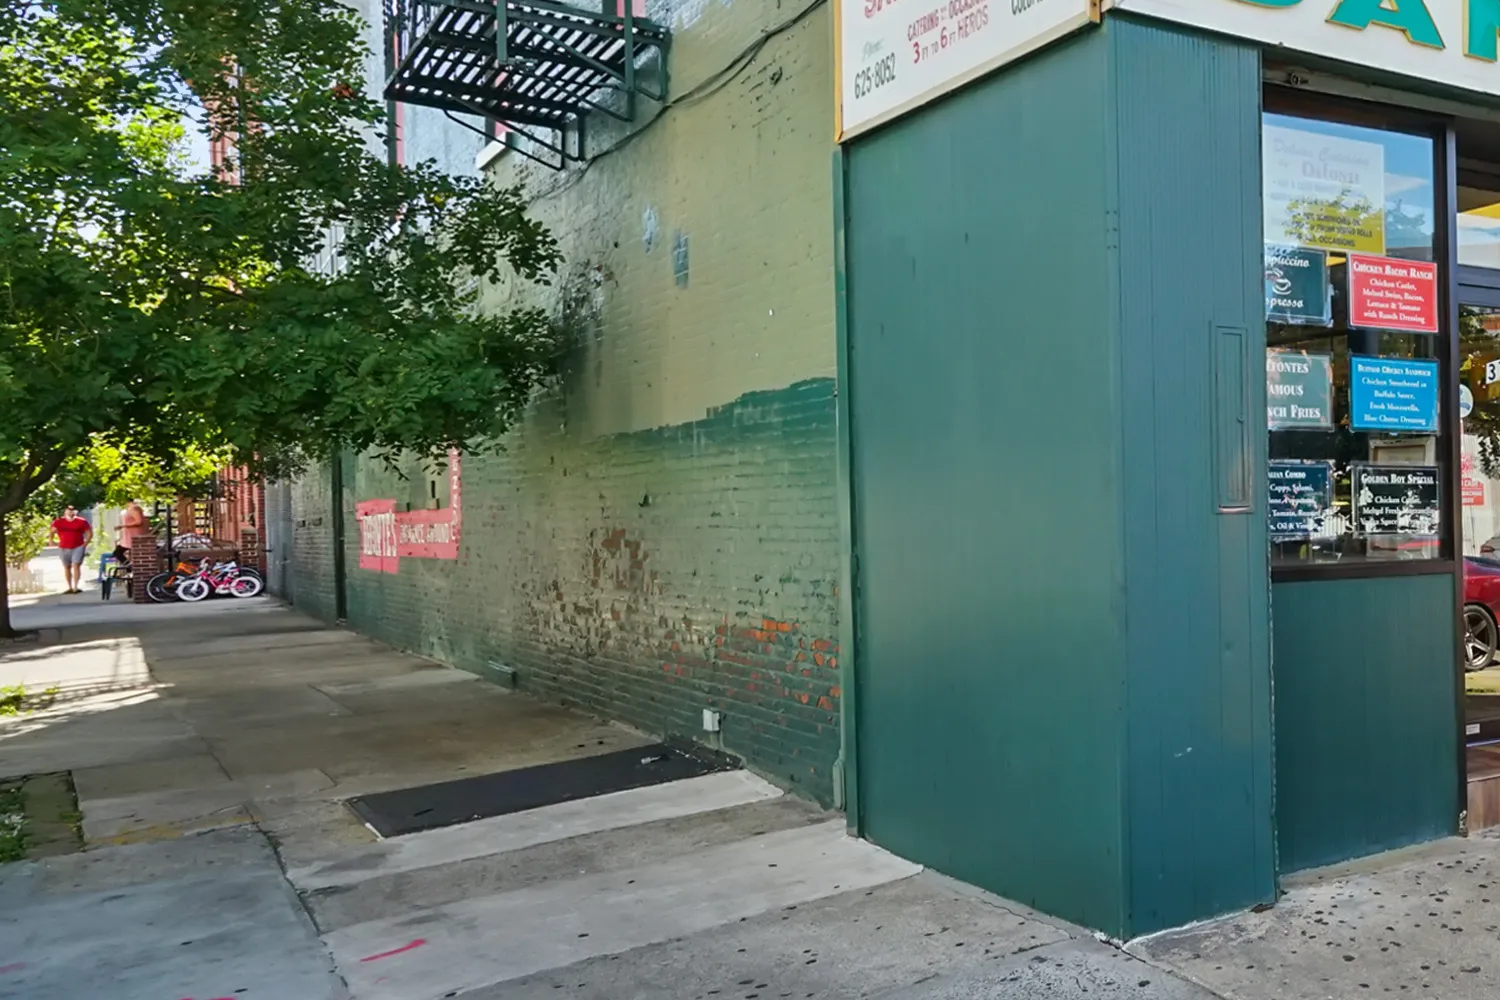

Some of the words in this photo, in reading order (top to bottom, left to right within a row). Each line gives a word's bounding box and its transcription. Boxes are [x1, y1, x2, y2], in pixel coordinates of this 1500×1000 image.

[907, 9, 940, 42] CATERING
[913, 41, 920, 64] 3
[941, 26, 948, 48] 6
[957, 4, 989, 40] HEROS
[1290, 405, 1321, 420] FRIES
[1284, 469, 1307, 480] COMBO
[1361, 473, 1390, 484] GOLDEN
[1390, 473, 1406, 485] BOY
[1407, 474, 1435, 485] SPECIAL
[1374, 495, 1400, 505] Chicken
